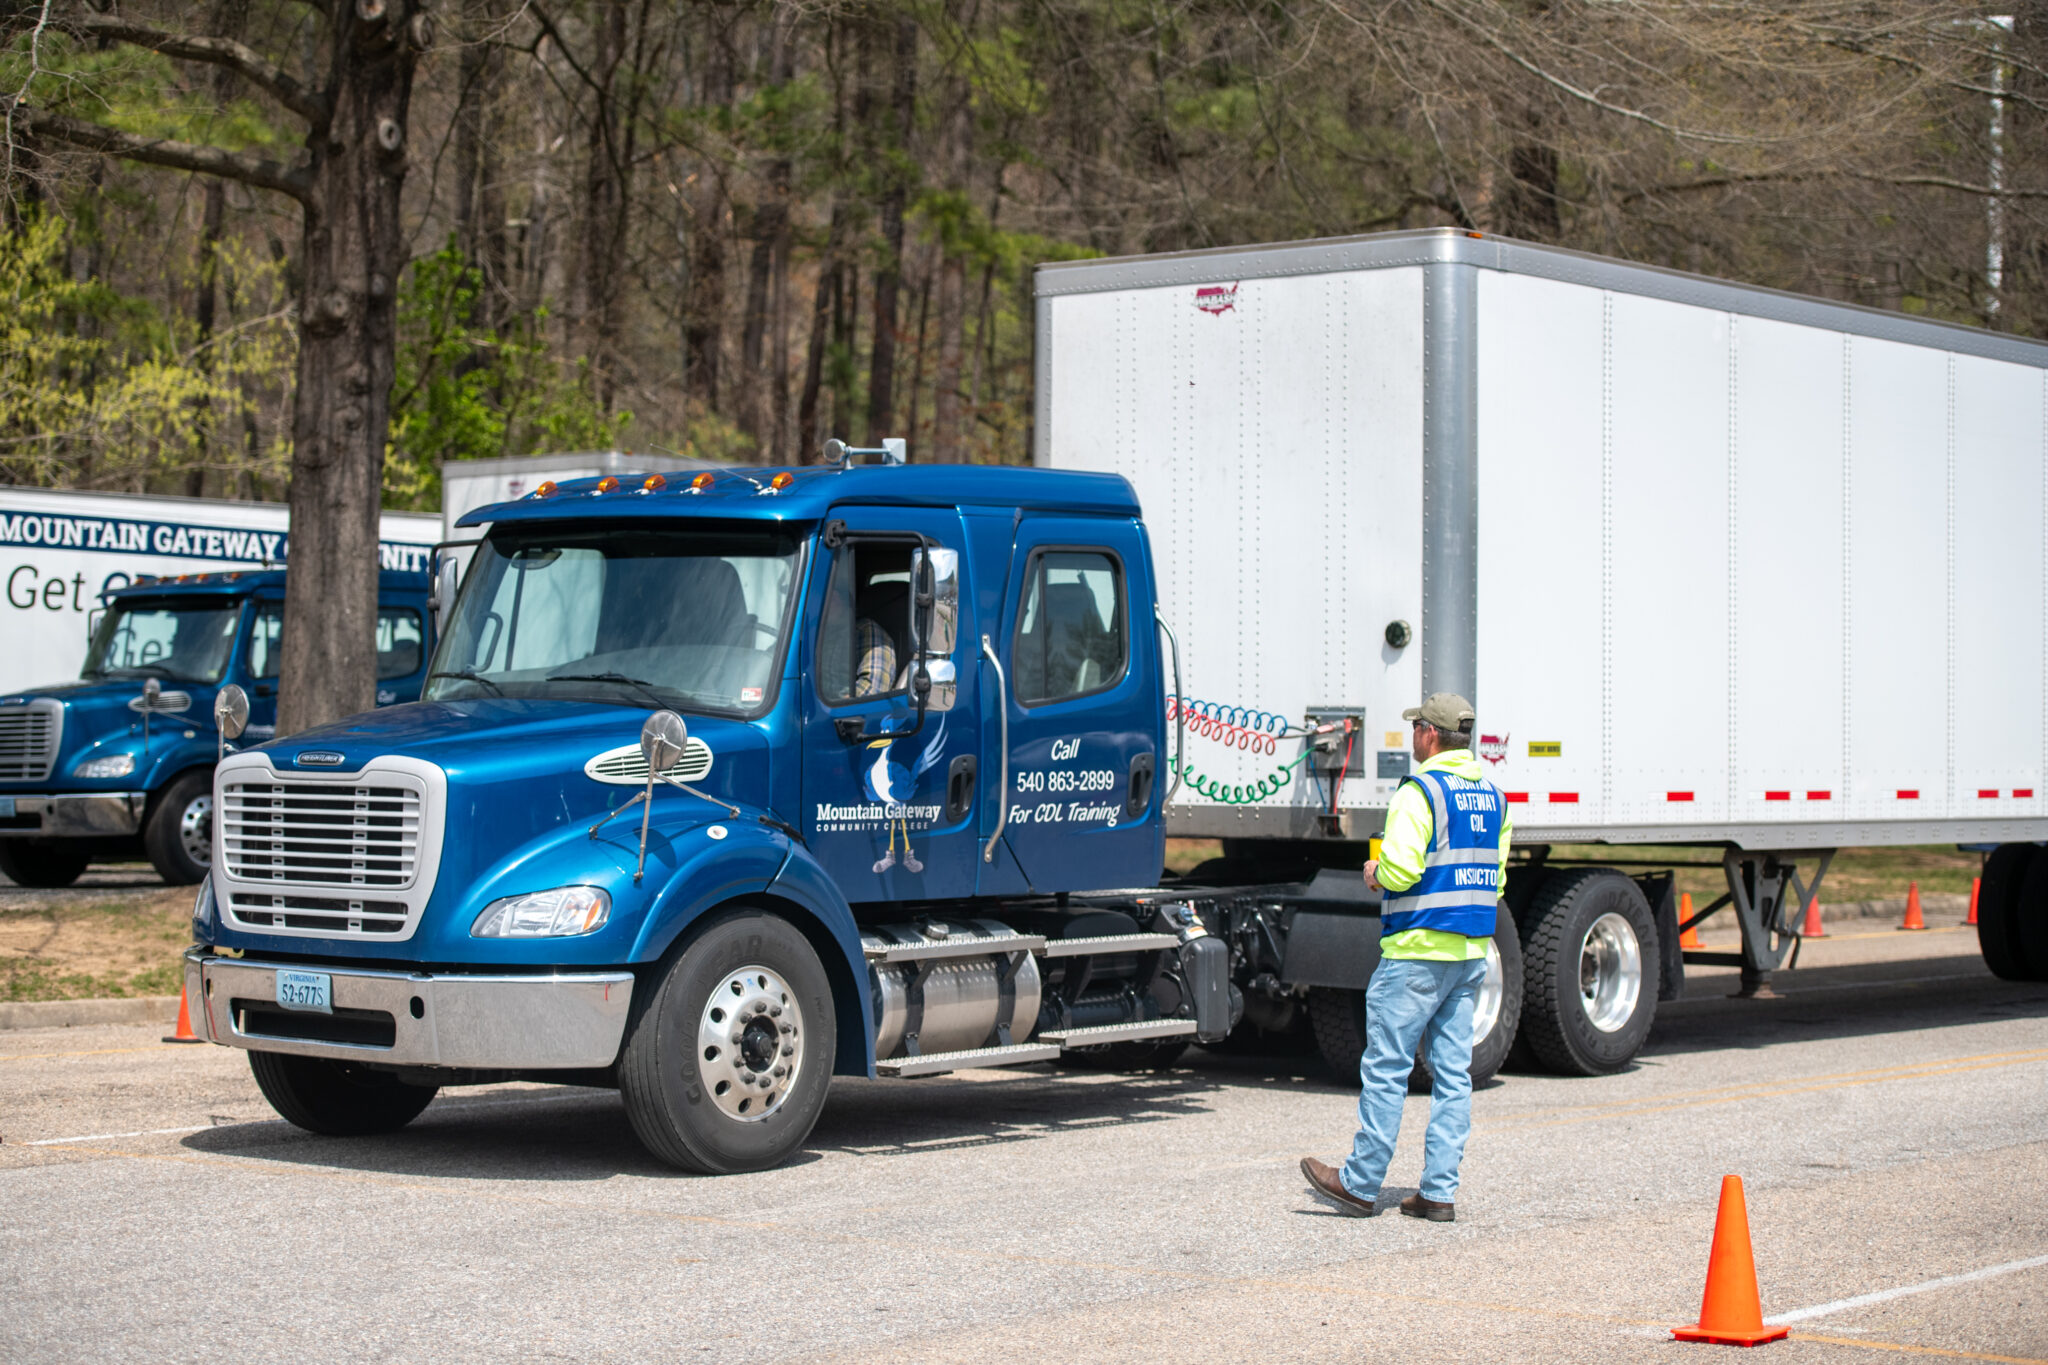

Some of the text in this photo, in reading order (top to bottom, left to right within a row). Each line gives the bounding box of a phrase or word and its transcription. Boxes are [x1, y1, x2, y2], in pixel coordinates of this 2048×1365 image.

[0, 513, 281, 561] MOUNTAIN GATEWAY
[7, 565, 86, 612] Get
[1051, 738, 1081, 760] Call
[1017, 770, 1115, 792] 540 863-2899
[816, 802, 941, 822] Mountain Gateway
[1455, 793, 1497, 812] GATEWAY
[1008, 801, 1121, 827] For CDL Training
[1470, 814, 1488, 833] CDL
[816, 823, 878, 832] COMMUNITY
